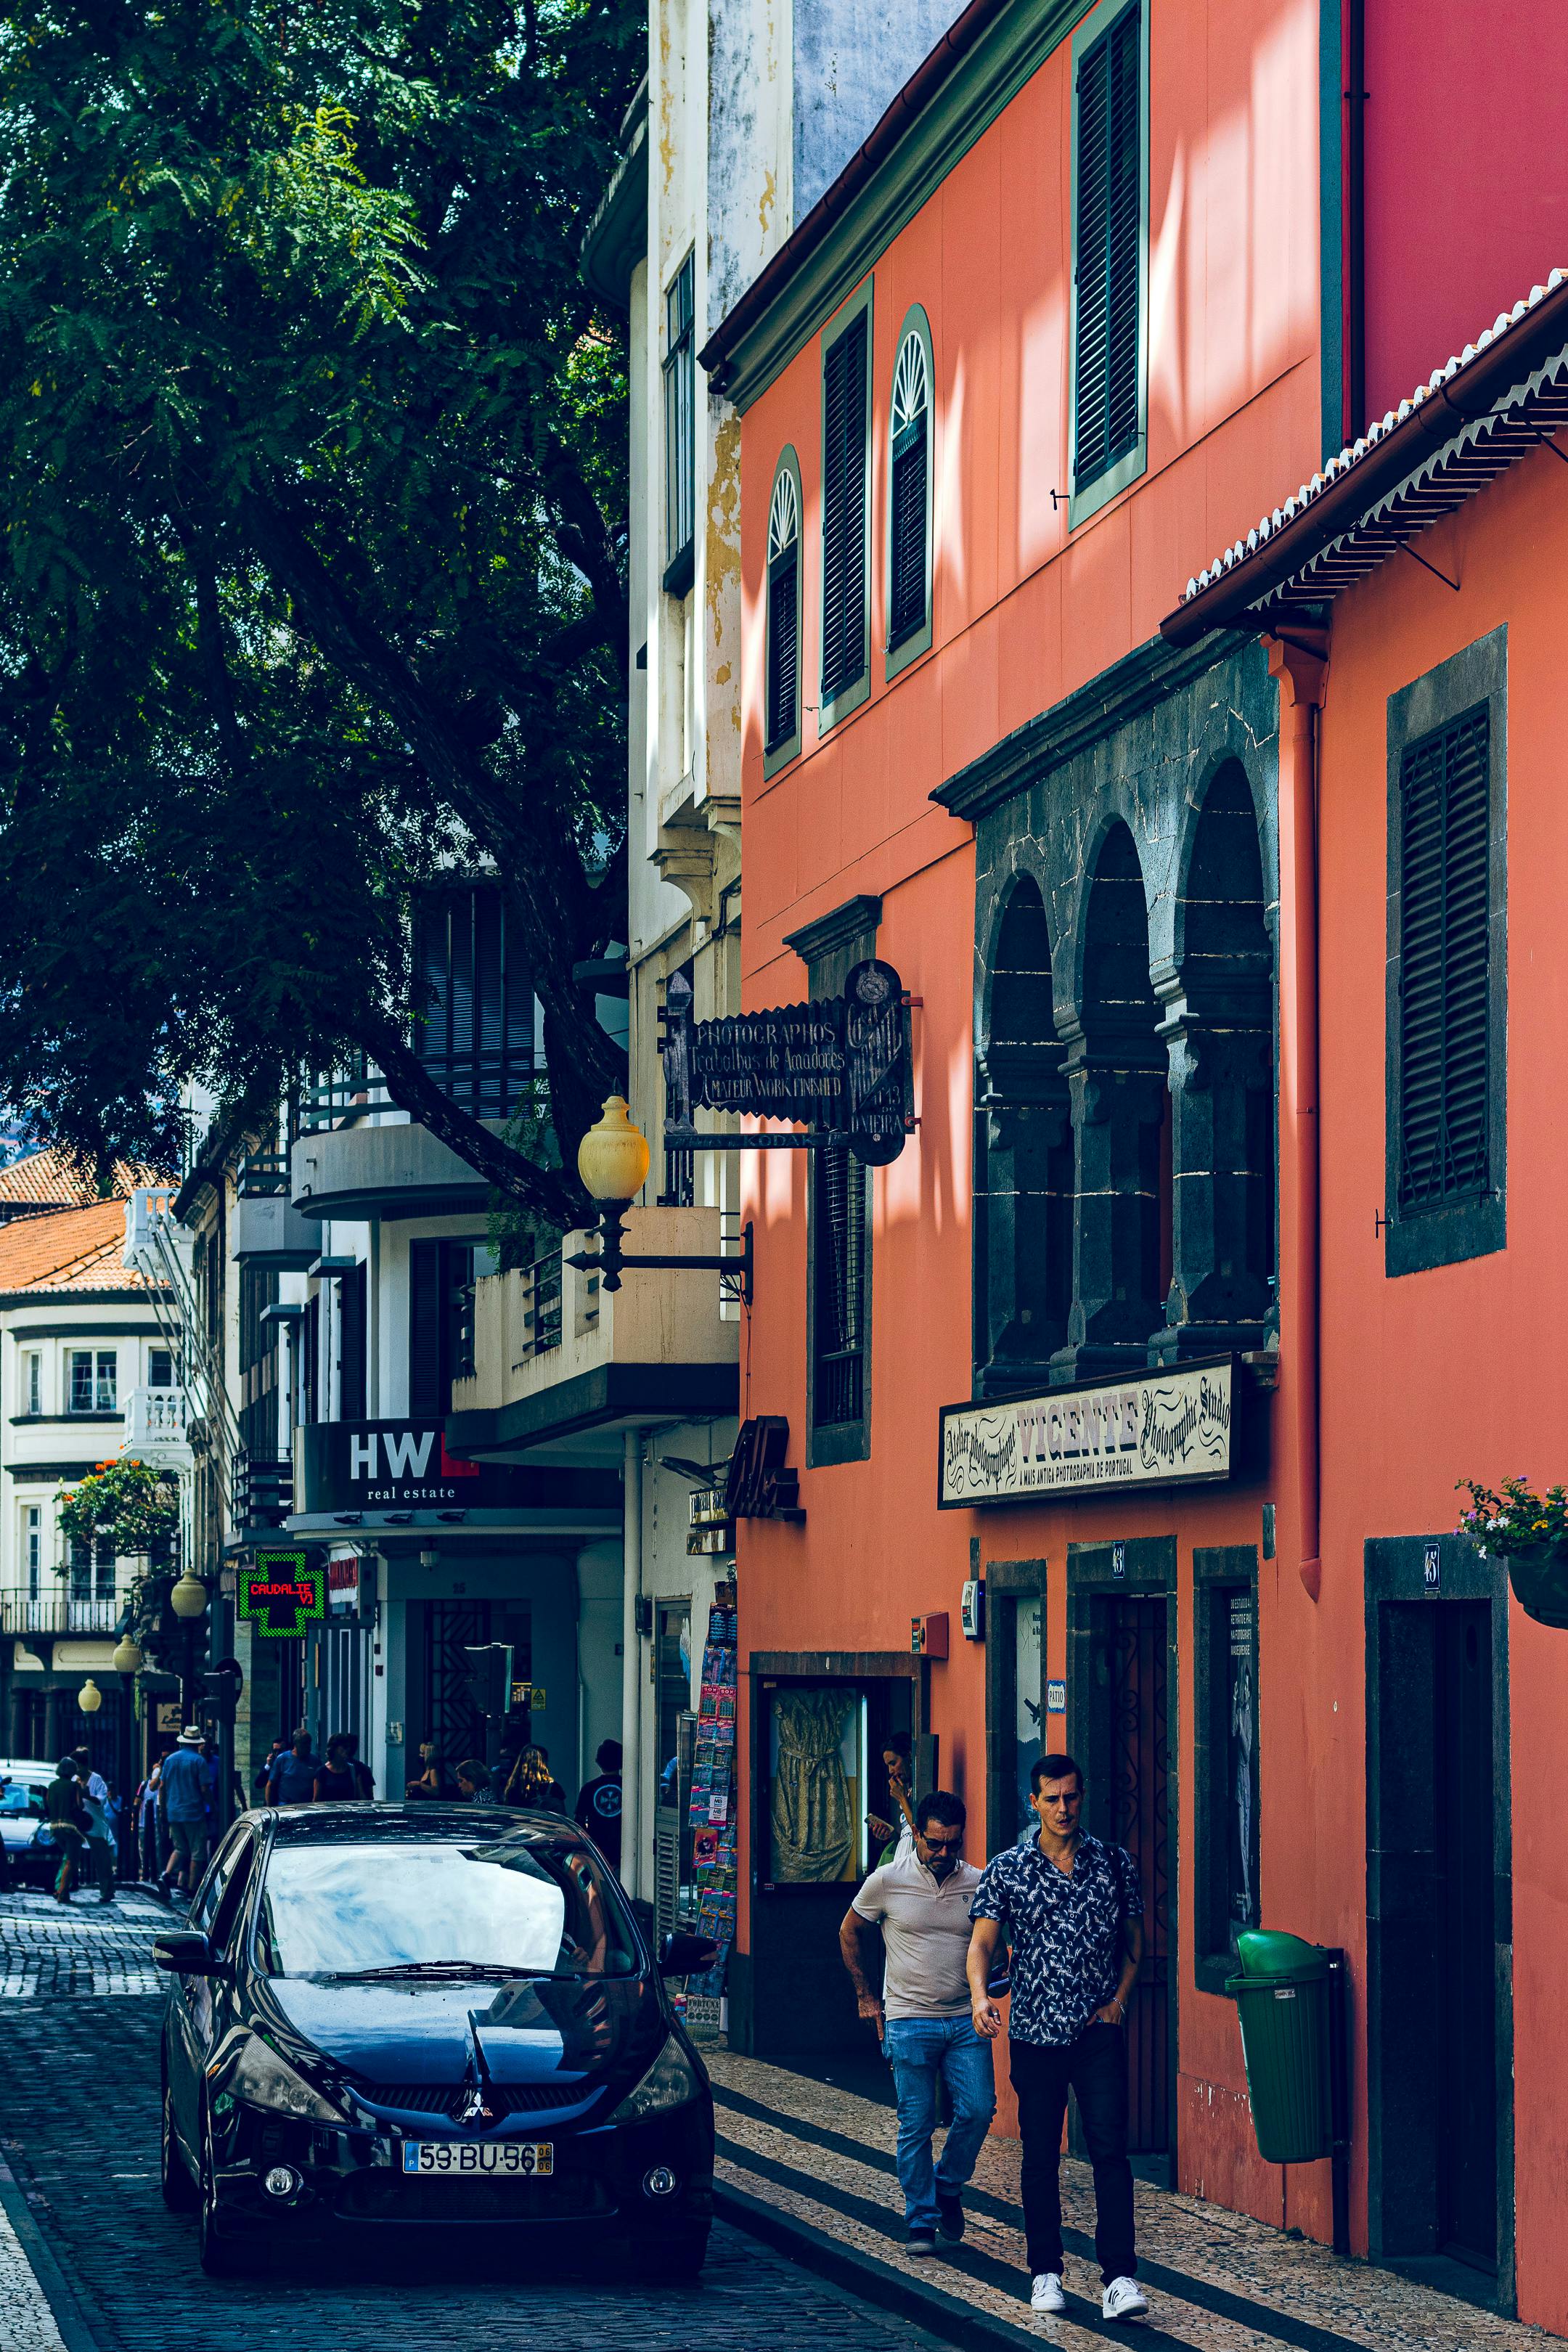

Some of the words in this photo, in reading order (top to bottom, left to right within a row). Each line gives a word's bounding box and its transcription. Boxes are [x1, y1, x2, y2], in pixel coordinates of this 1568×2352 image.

[697, 1021, 836, 1046] PHOTOGRAPHOS
[766, 1045, 780, 1070] de
[785, 1045, 846, 1071] Amadores
[751, 1071, 792, 1097] WORK
[793, 1077, 842, 1098] FINISHED
[743, 1135, 814, 1148] KODAK
[1016, 1391, 1139, 1464] VICENTE
[1141, 1389, 1198, 1466] Photographic
[1199, 1376, 1230, 1432] Studio
[946, 1416, 971, 1466] Atelier
[1019, 1470, 1023, 1487] A
[1024, 1469, 1036, 1486] MAIS
[1037, 1466, 1055, 1485] ANTIGA
[1055, 1461, 1095, 1483] PHOTOGRAPHIA
[1096, 1461, 1103, 1479] DE
[1105, 1458, 1133, 1477] PORTUGAL
[367, 1487, 396, 1500] real
[404, 1487, 455, 1499] estate
[1424, 1550, 1437, 1583] 45
[250, 1583, 312, 1595] CAUDALIE
[1049, 1687, 1063, 1703] PÁTIO
[539, 2147, 550, 2156] 06
[539, 2162, 550, 2171] 06
